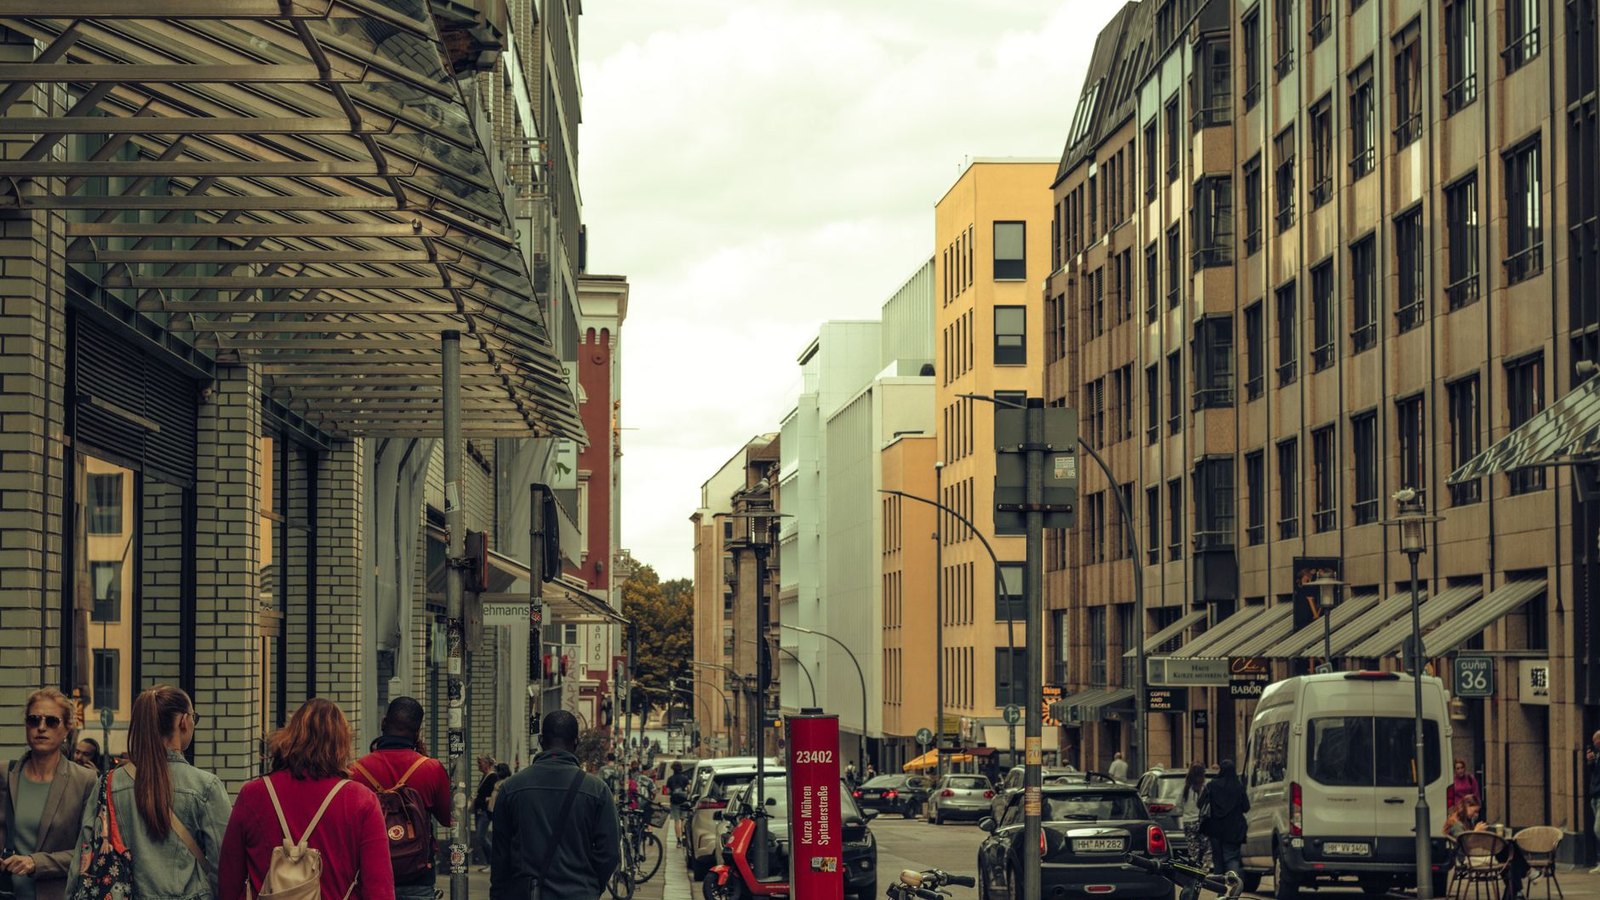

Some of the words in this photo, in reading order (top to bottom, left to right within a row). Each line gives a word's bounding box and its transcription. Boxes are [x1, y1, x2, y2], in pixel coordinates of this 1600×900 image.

[1461, 670, 1487, 689] 36
[796, 750, 833, 764] 23402
[801, 785, 812, 818] Mühren
[817, 785, 831, 846] Spitalerstraße
[801, 821, 812, 845] Kurze
[1106, 840, 1122, 849] 282
